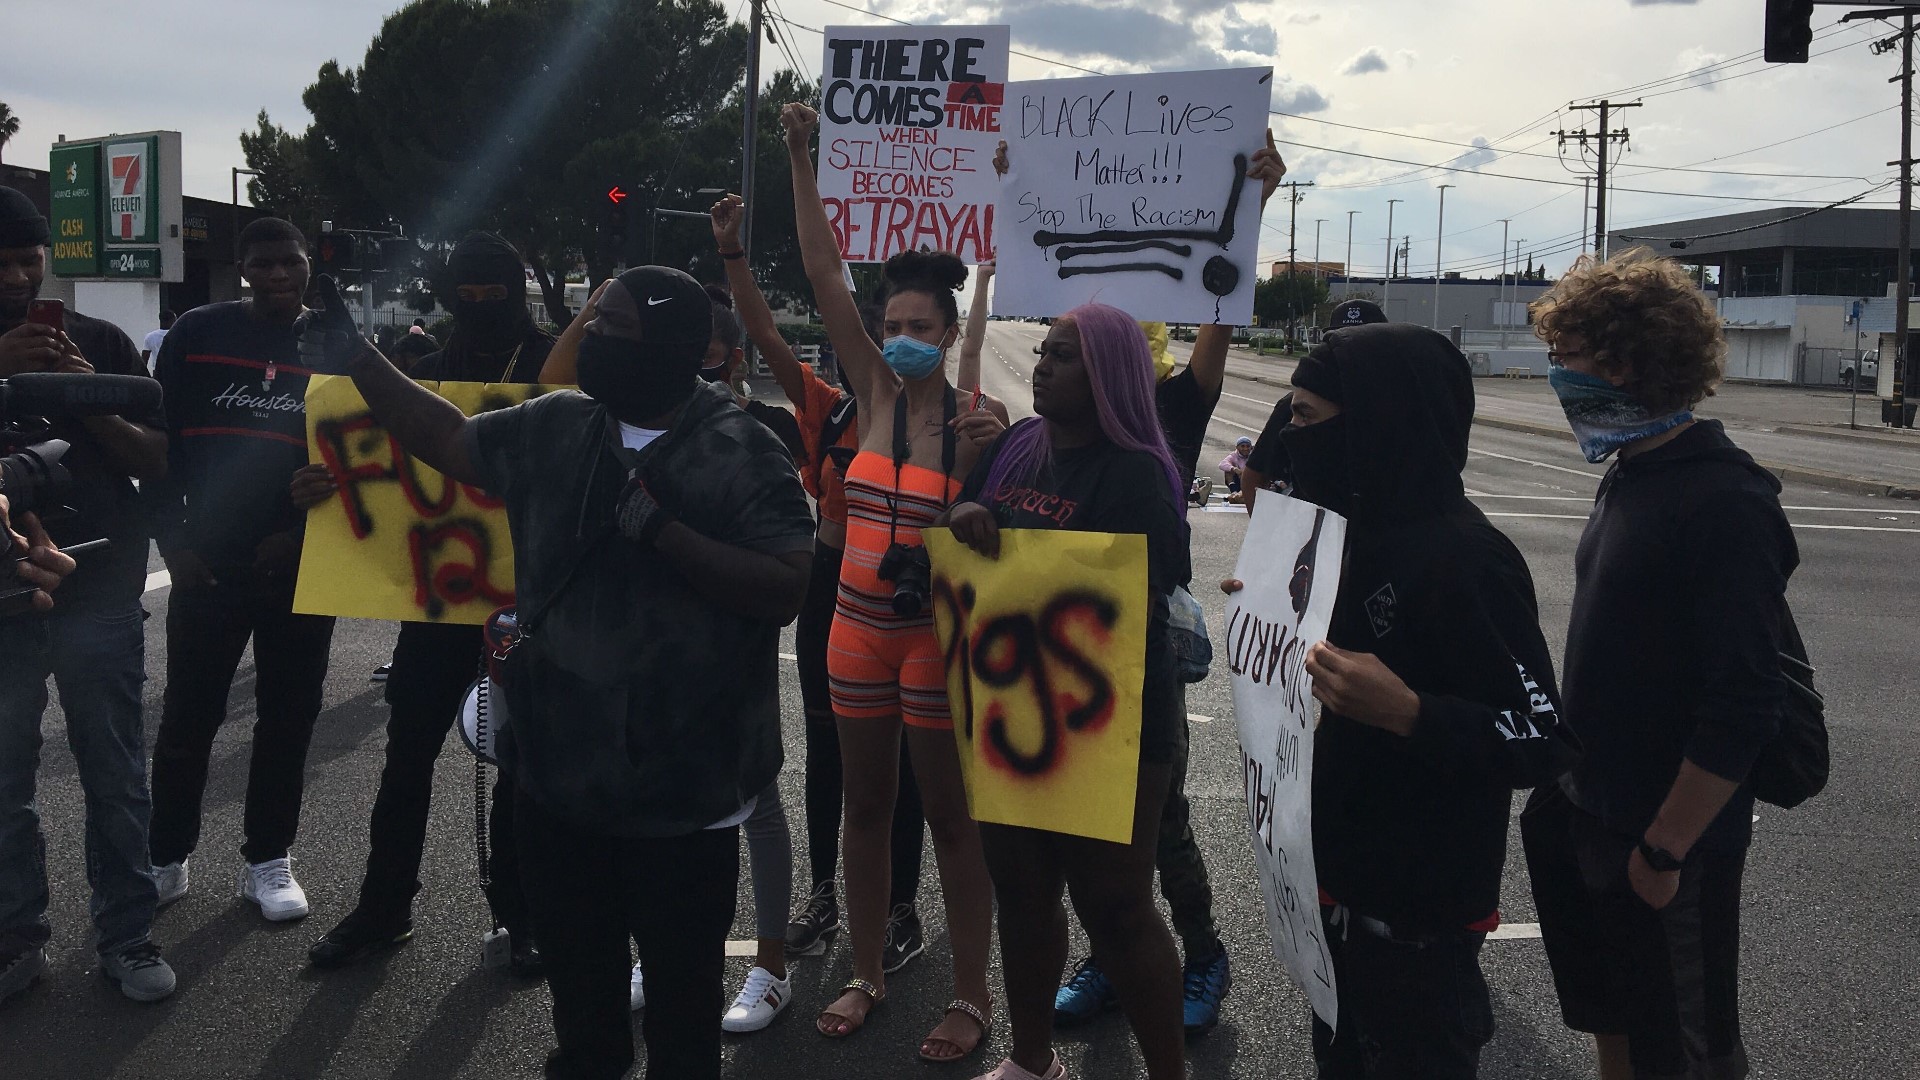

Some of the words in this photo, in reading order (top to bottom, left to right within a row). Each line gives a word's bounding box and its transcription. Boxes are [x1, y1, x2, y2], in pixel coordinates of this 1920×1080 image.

[828, 38, 986, 82] THERE
[824, 80, 944, 128] COMES
[960, 84, 985, 104] A
[943, 104, 1000, 132] TIME
[1020, 90, 1115, 139] BLACK
[1125, 90, 1234, 136] Lives
[878, 127, 938, 145] WHEN
[828, 139, 976, 172] SILENCE
[1074, 142, 1182, 185] Matter!!!
[72, 188, 89, 197] AMERICA
[852, 170, 954, 198] BECOMES
[1018, 192, 1065, 232] Stop
[1076, 193, 1117, 228] The
[61, 218, 83, 236] CASH
[54, 241, 93, 259] ADVANCE
[120, 254, 134, 271] 24
